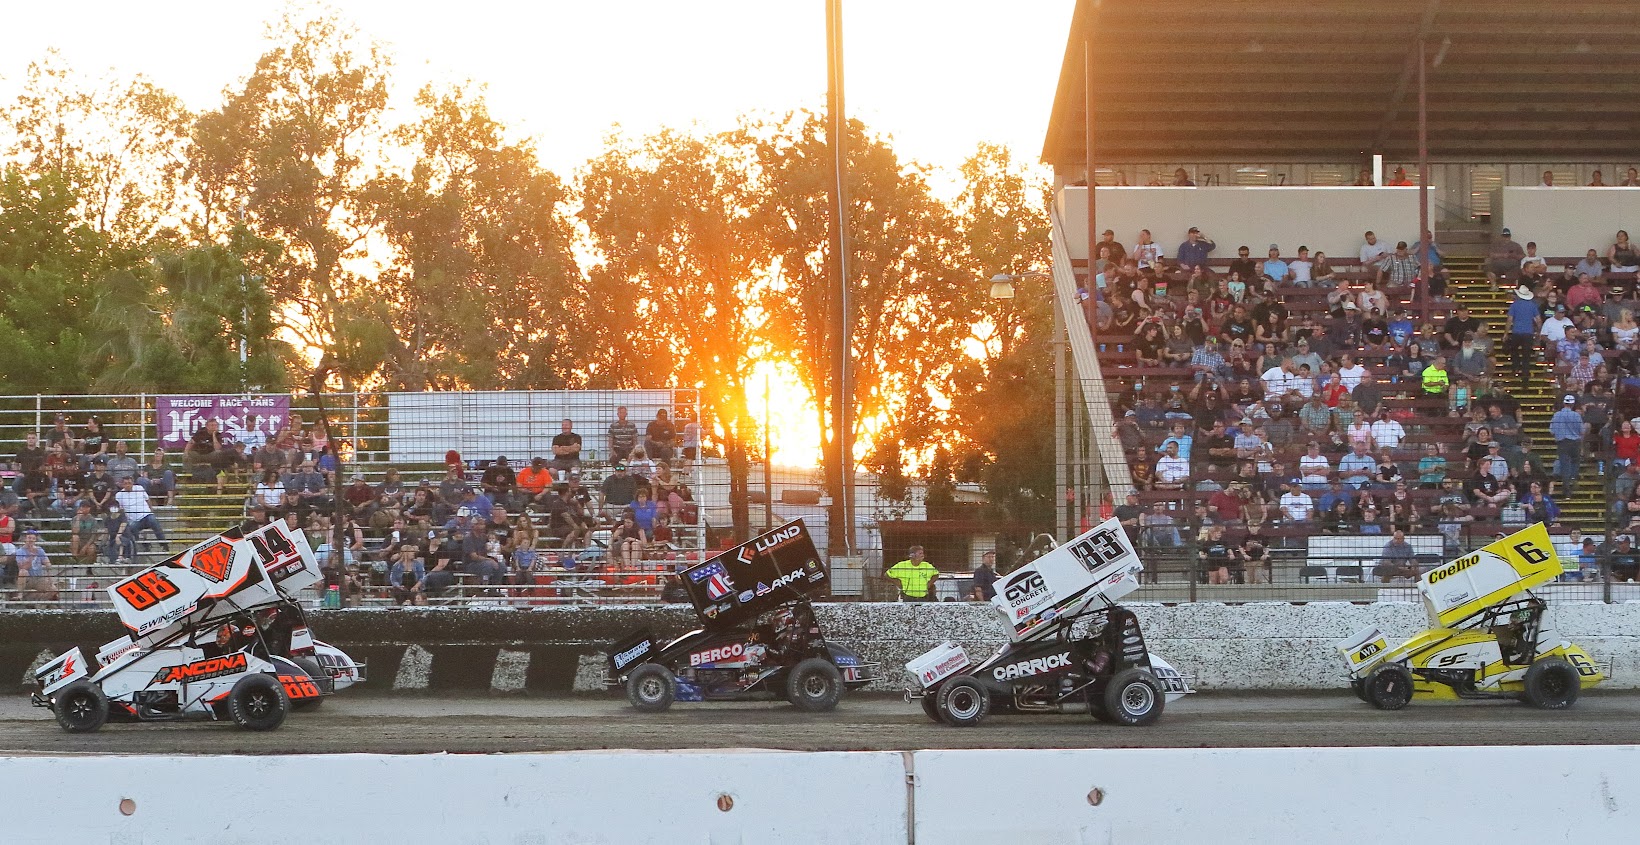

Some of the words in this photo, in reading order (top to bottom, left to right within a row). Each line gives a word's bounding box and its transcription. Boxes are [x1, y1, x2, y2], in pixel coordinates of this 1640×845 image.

[170, 399, 213, 408] WELCOME
[219, 399, 242, 407] RACE
[250, 399, 275, 407] FANS
[756, 525, 800, 552] LUND
[771, 568, 806, 591] ARAK
[1428, 554, 1480, 584] Coelho
[115, 569, 181, 611] 88
[1005, 574, 1045, 602] CVC
[1010, 585, 1049, 608] CONCRETE
[139, 600, 198, 633] SWINDELL
[690, 643, 743, 667] BERCO
[993, 651, 1073, 681] CARRICK
[183, 667, 247, 684] OTORSPORTS
